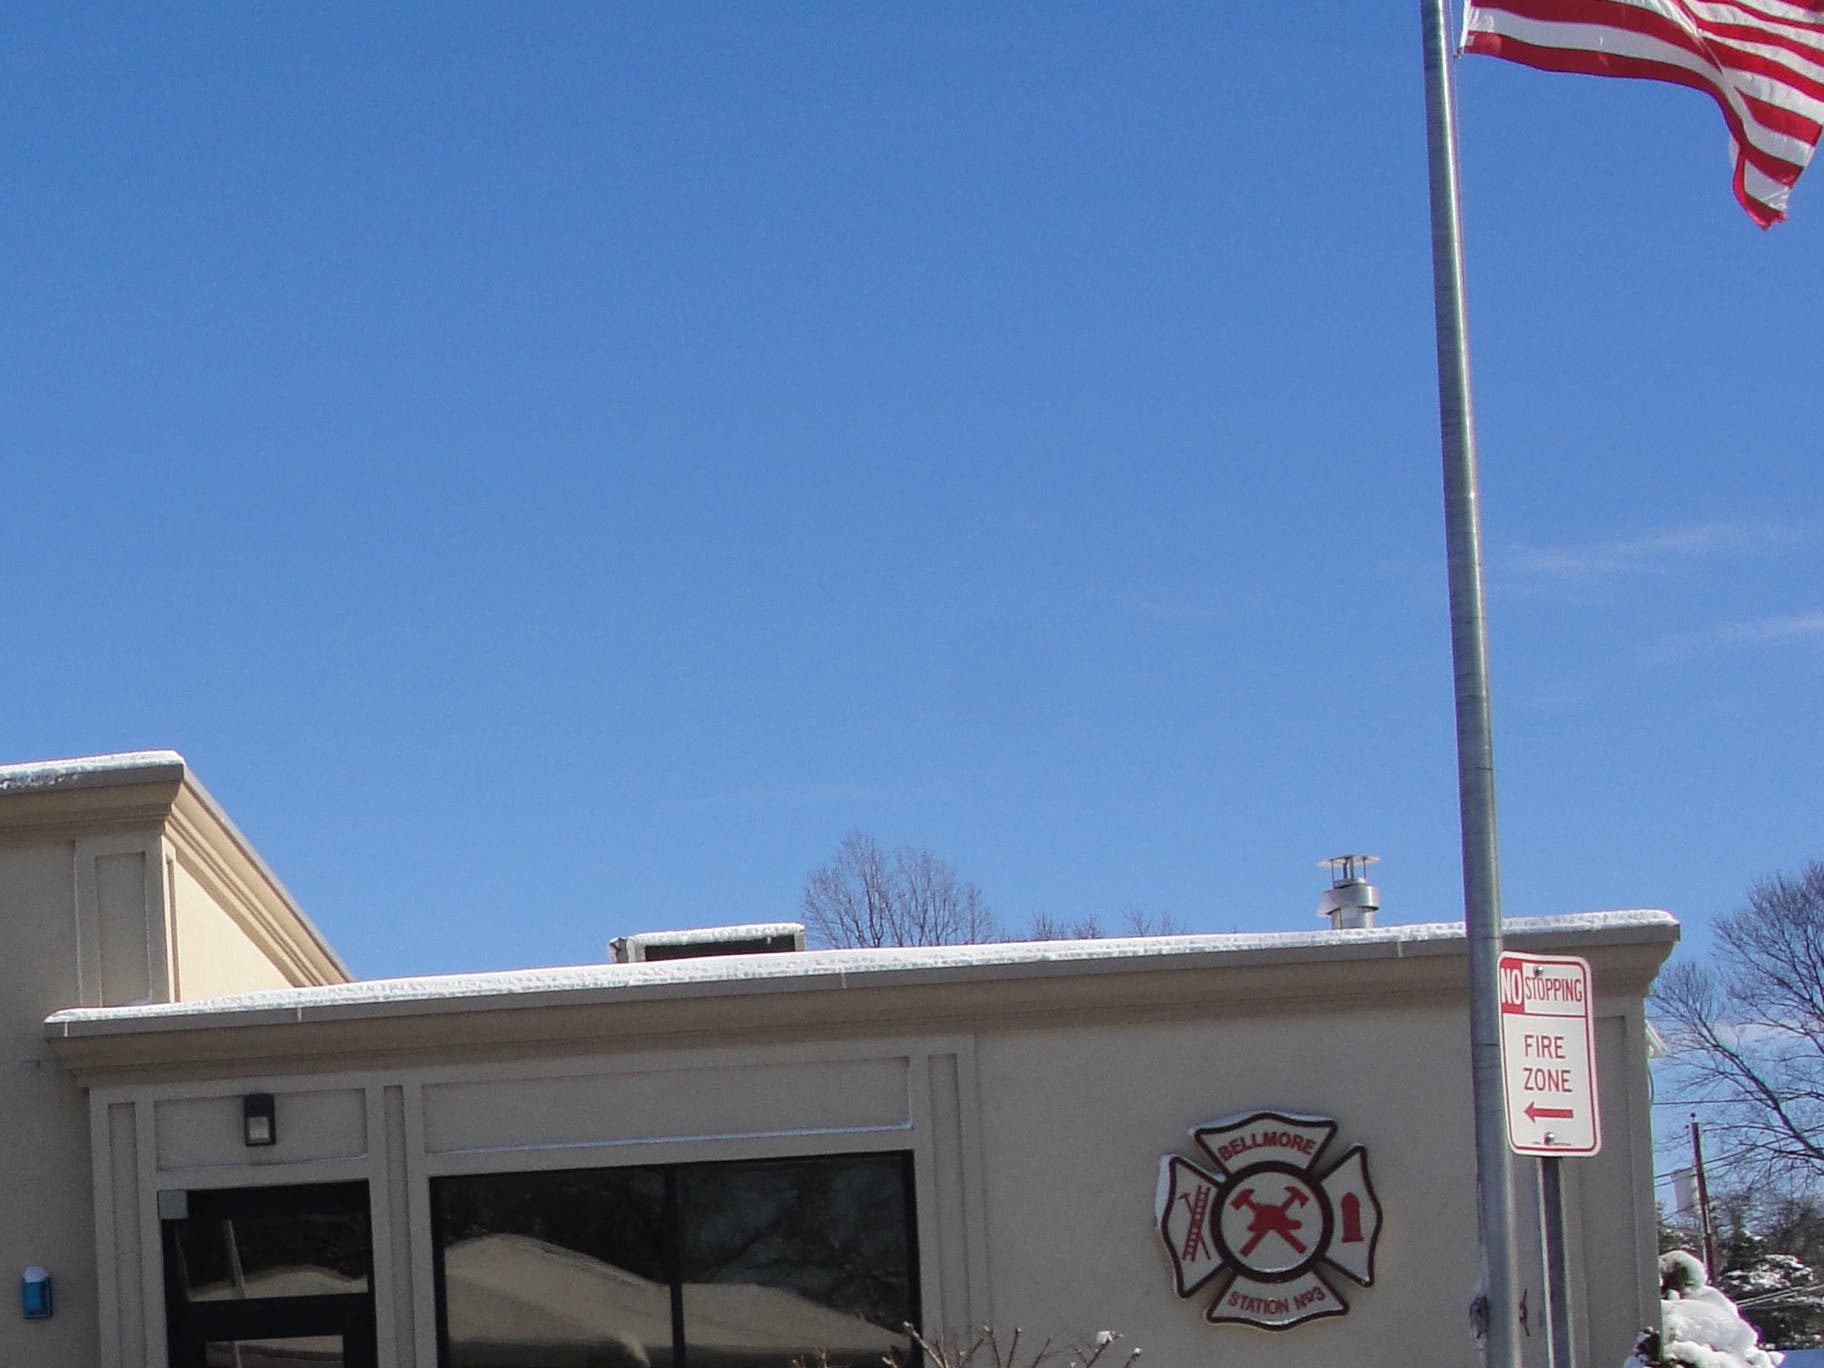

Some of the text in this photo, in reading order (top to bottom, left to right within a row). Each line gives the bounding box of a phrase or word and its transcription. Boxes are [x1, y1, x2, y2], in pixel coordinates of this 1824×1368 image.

[1500, 967, 1582, 1005] NO STOPPING
[1524, 1034, 1565, 1059] FIRE
[1523, 1067, 1572, 1092] ZONE
[1217, 1131, 1316, 1162] BELLMORE
[1228, 1291, 1290, 1315] STATION
